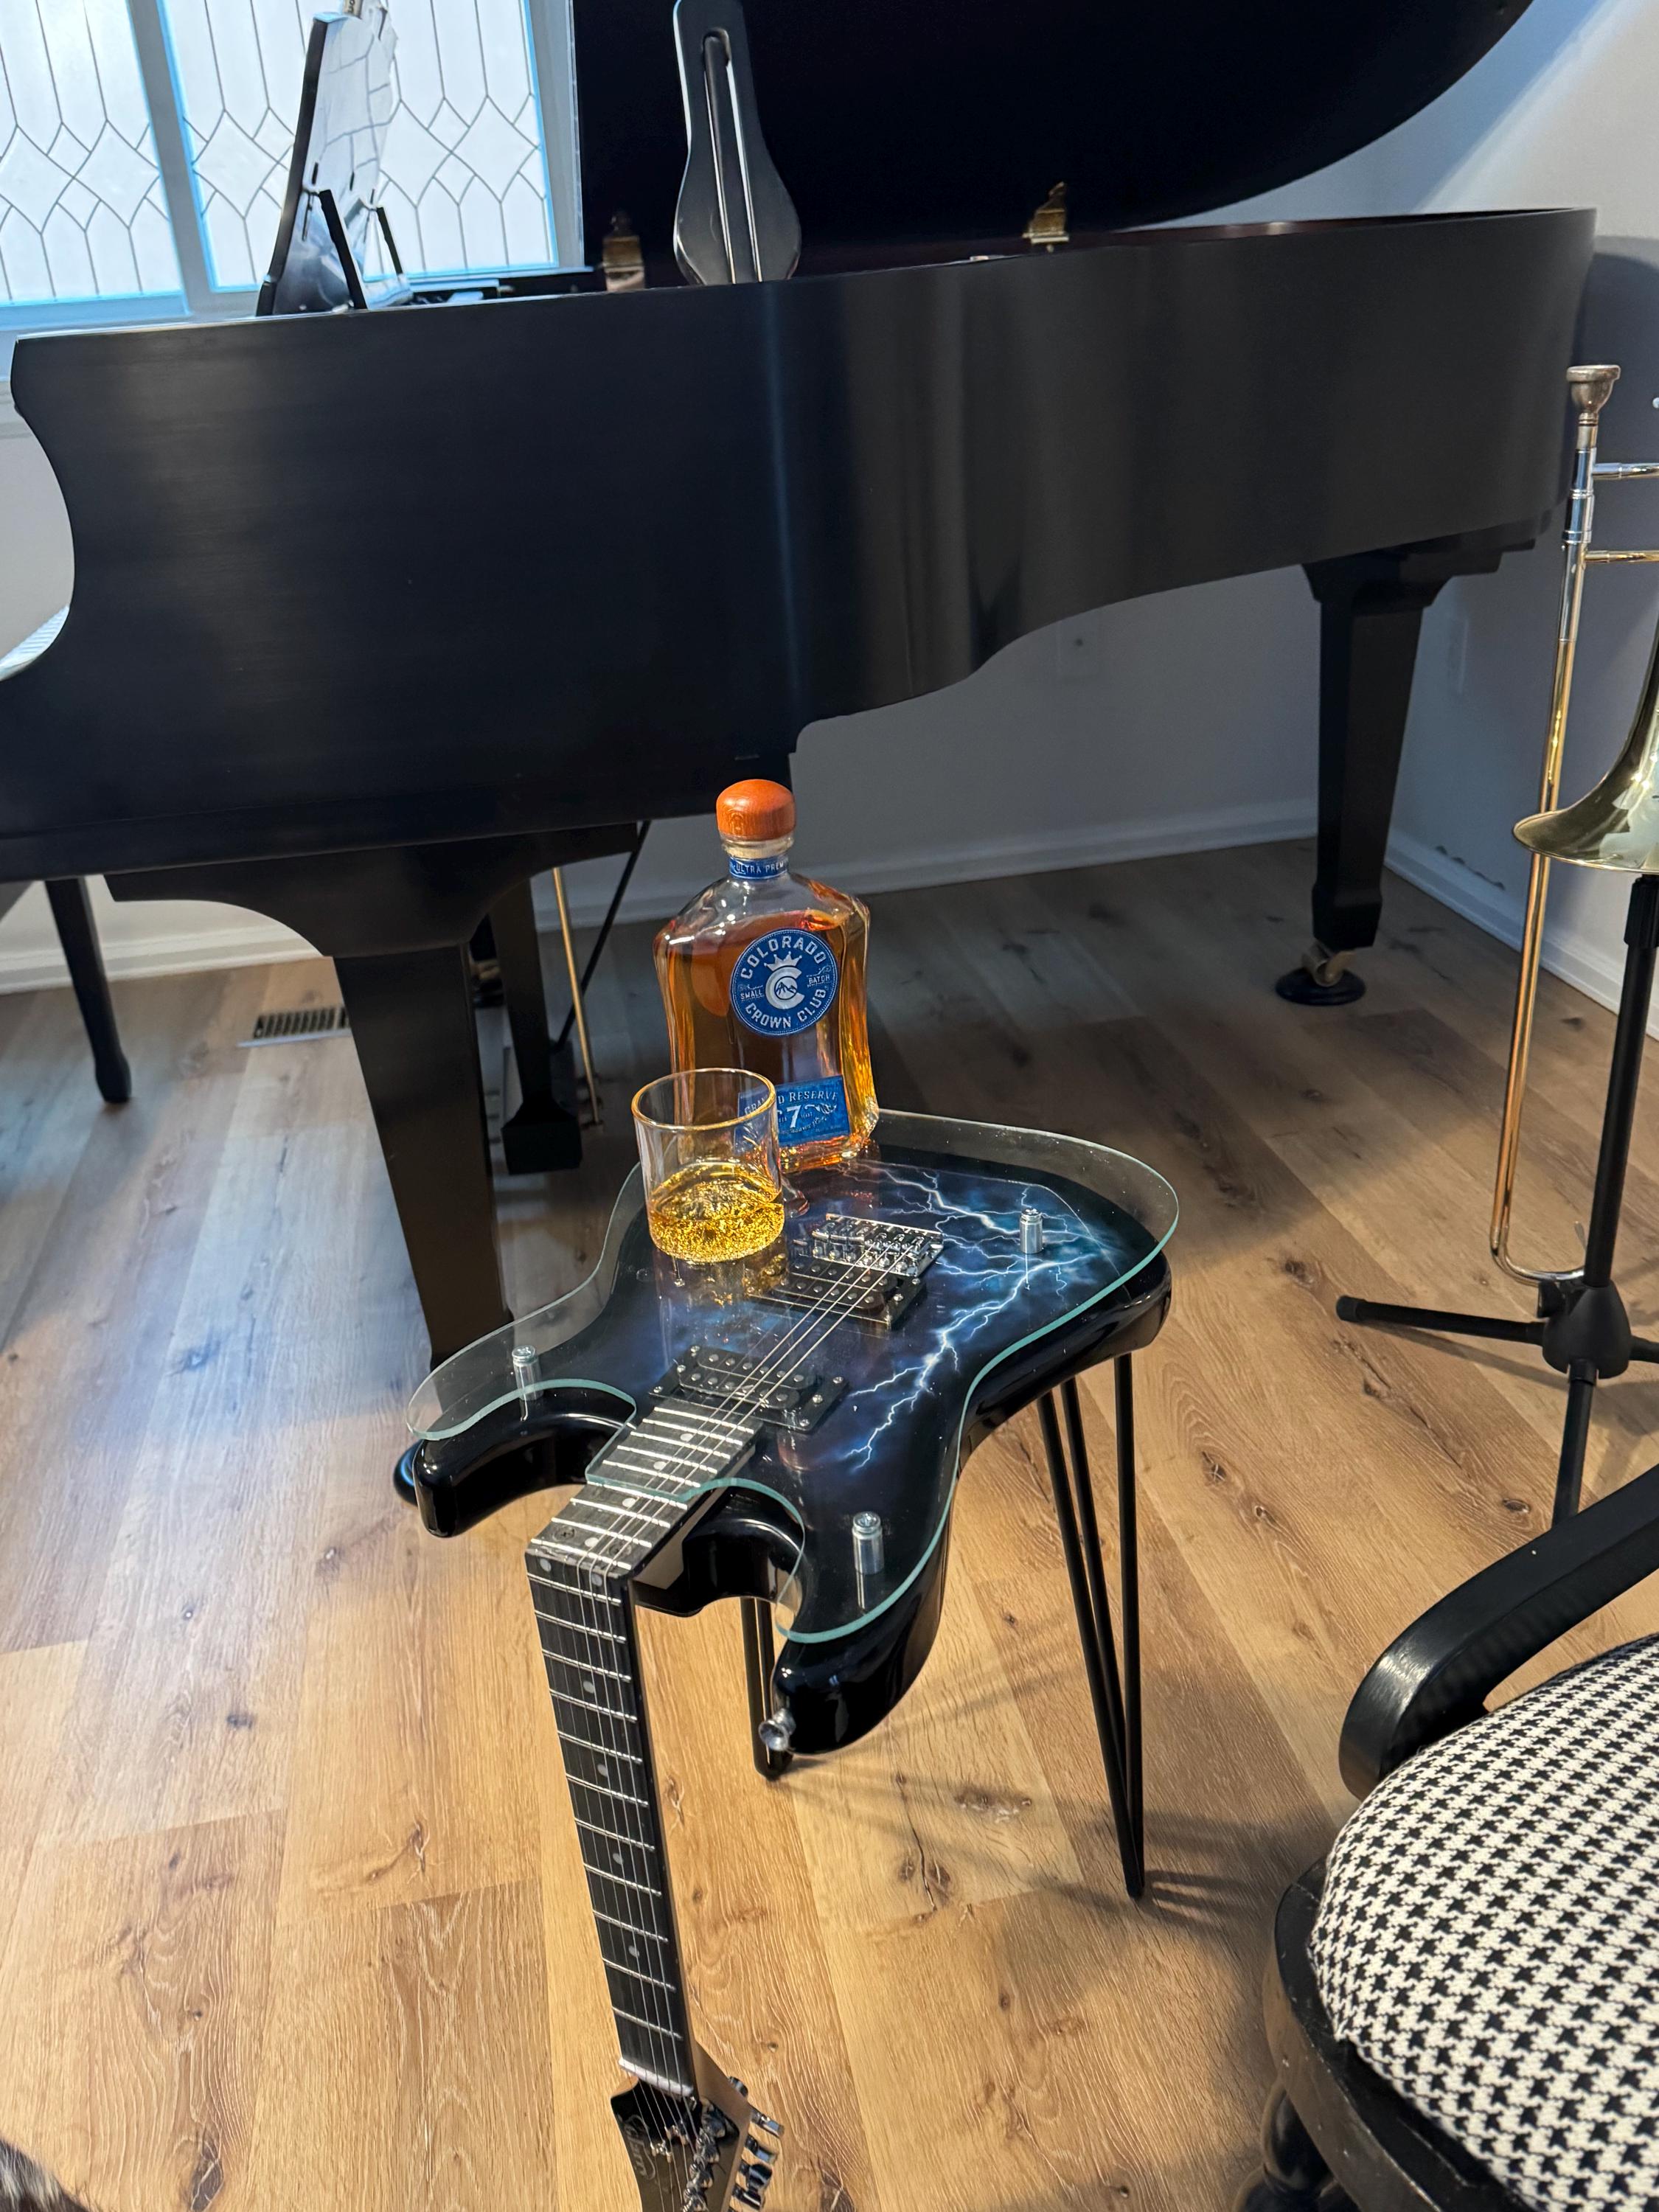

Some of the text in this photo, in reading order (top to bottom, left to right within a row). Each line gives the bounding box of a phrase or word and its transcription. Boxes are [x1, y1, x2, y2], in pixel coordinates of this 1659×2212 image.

[736, 862, 762, 874] ULTRA
[740, 935, 827, 979] COLORADO
[808, 973, 830, 984] BATCH
[740, 989, 763, 1000] SMALL
[745, 988, 827, 1029] CROWN CLUB
[789, 1091, 838, 1102] RESERVE
[786, 1105, 802, 1128] 7
